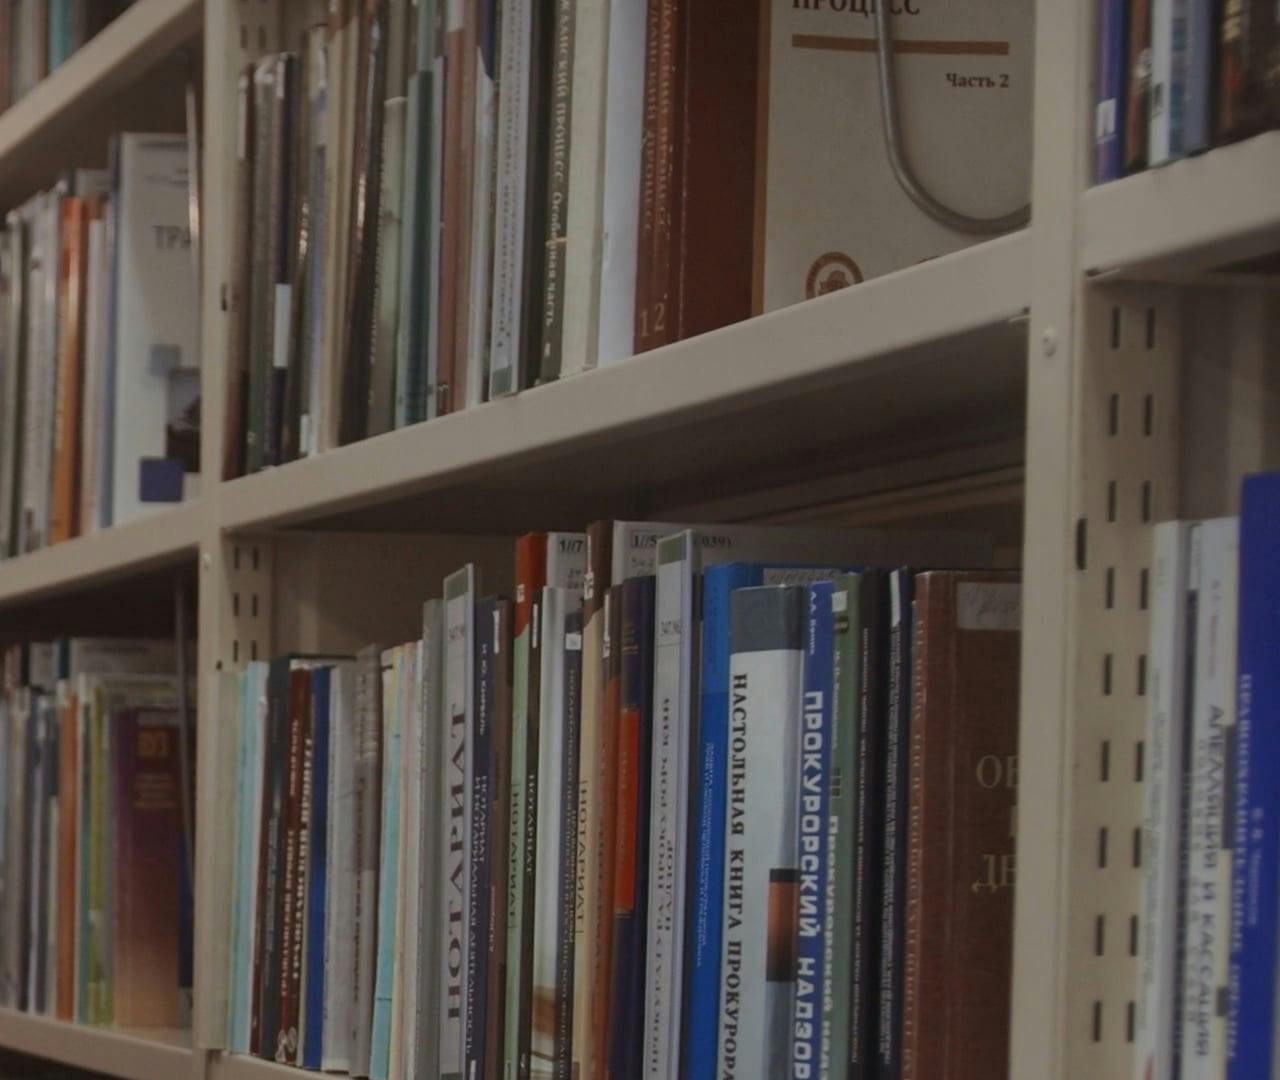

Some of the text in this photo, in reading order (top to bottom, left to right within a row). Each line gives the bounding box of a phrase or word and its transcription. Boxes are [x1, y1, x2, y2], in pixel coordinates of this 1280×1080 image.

[946, 72, 1010, 89] Часть 2
[730, 673, 747, 836] НАСТОЛЬНАЯ
[1204, 704, 1223, 868] АПЕЛЛЯЦИЯ
[1231, 673, 1252, 953] ПРАВООХРАНИТЕЛЬНЫЕ
[447, 701, 465, 1020] НОТАРИАТ
[728, 848, 744, 928] КНИГА
[794, 690, 824, 1080] ПРОКУРОРСКИЙ НАДЗОР
[820, 816, 840, 1010] Прокурорский
[1197, 911, 1214, 1054] КАССАЦИЯ
